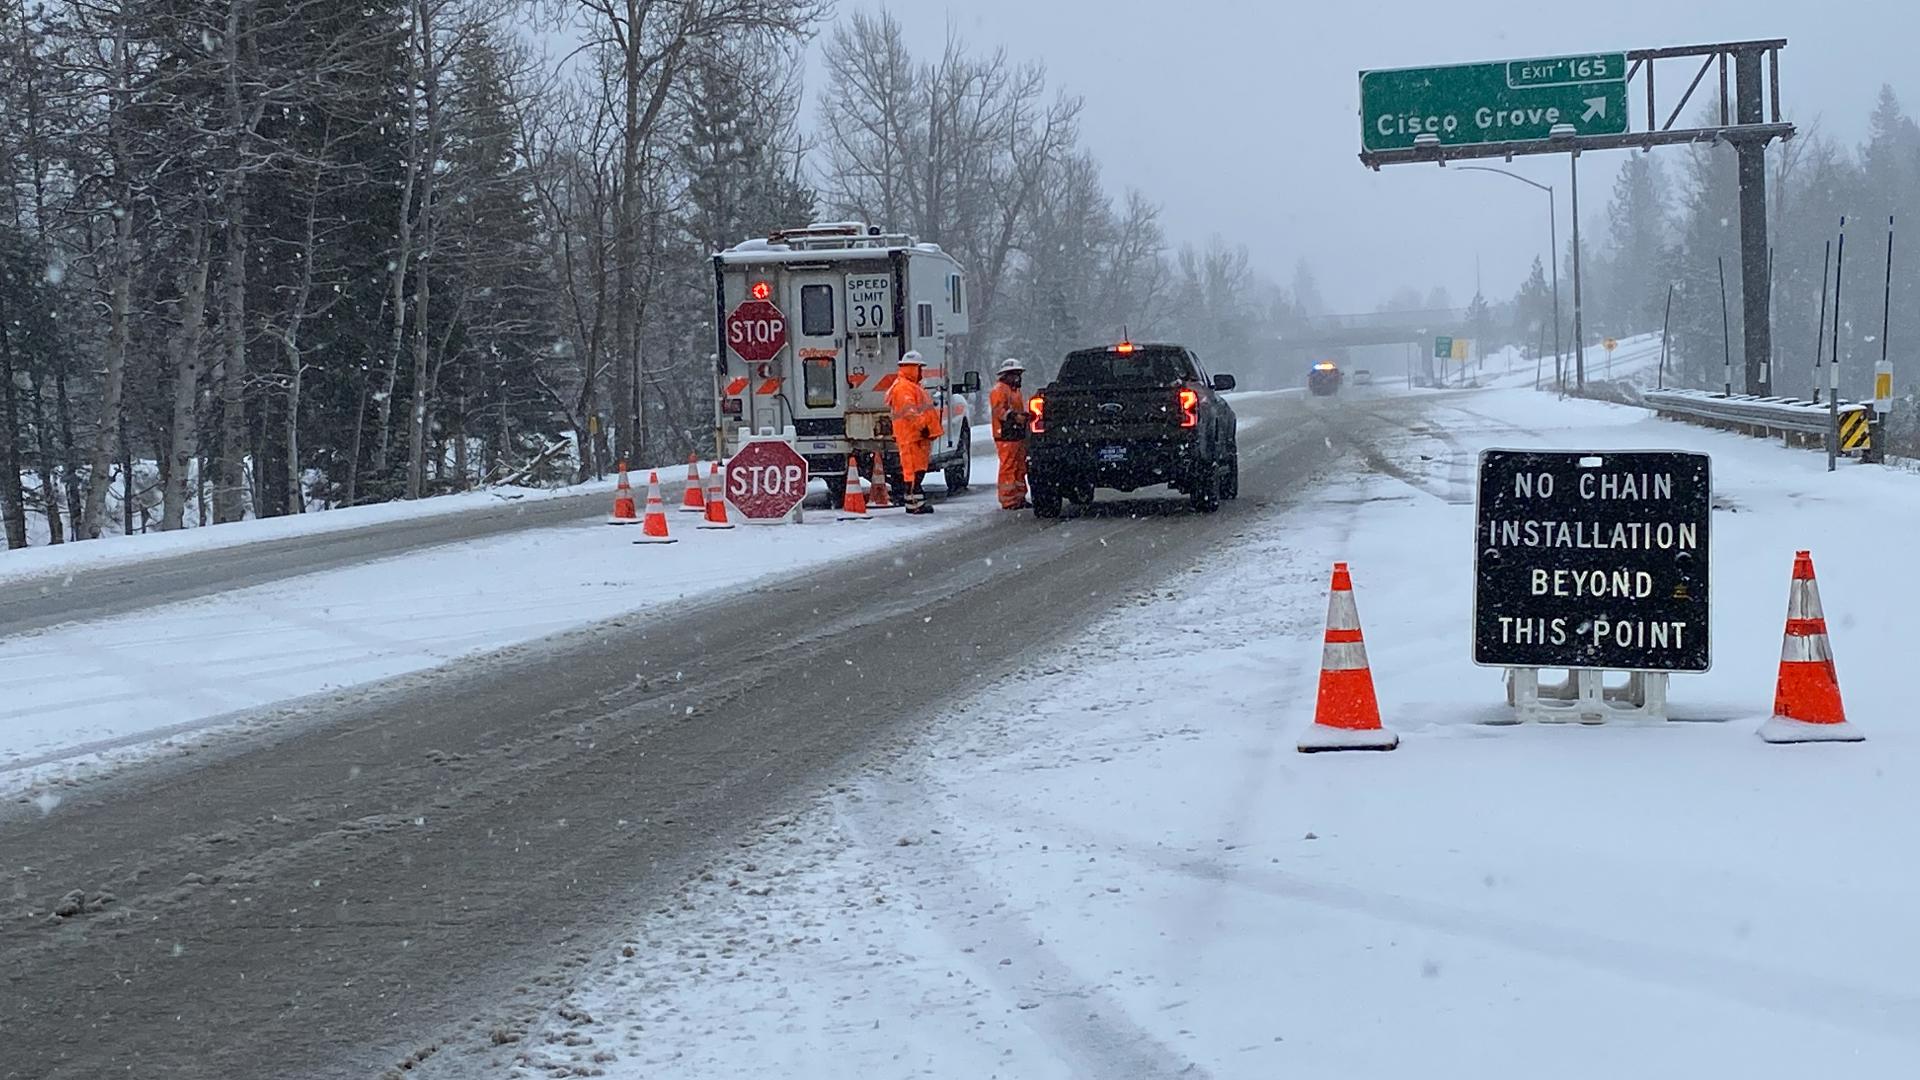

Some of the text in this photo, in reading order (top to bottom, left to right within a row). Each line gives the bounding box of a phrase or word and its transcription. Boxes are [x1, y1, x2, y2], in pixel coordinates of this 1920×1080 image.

[1522, 60, 1607, 80] EXIT 165
[1377, 106, 1560, 136] Cisco Grove
[848, 279, 888, 290] SPEED
[853, 291, 884, 302] LIMIT
[854, 304, 884, 327] 30
[731, 319, 783, 343] STOP
[730, 465, 802, 497] STOP
[1515, 472, 1672, 500] NO CHAIN
[1490, 520, 1697, 550] INSTALLATION
[1531, 569, 1652, 598] BEYOND
[1498, 617, 1687, 649] THIS POINT
